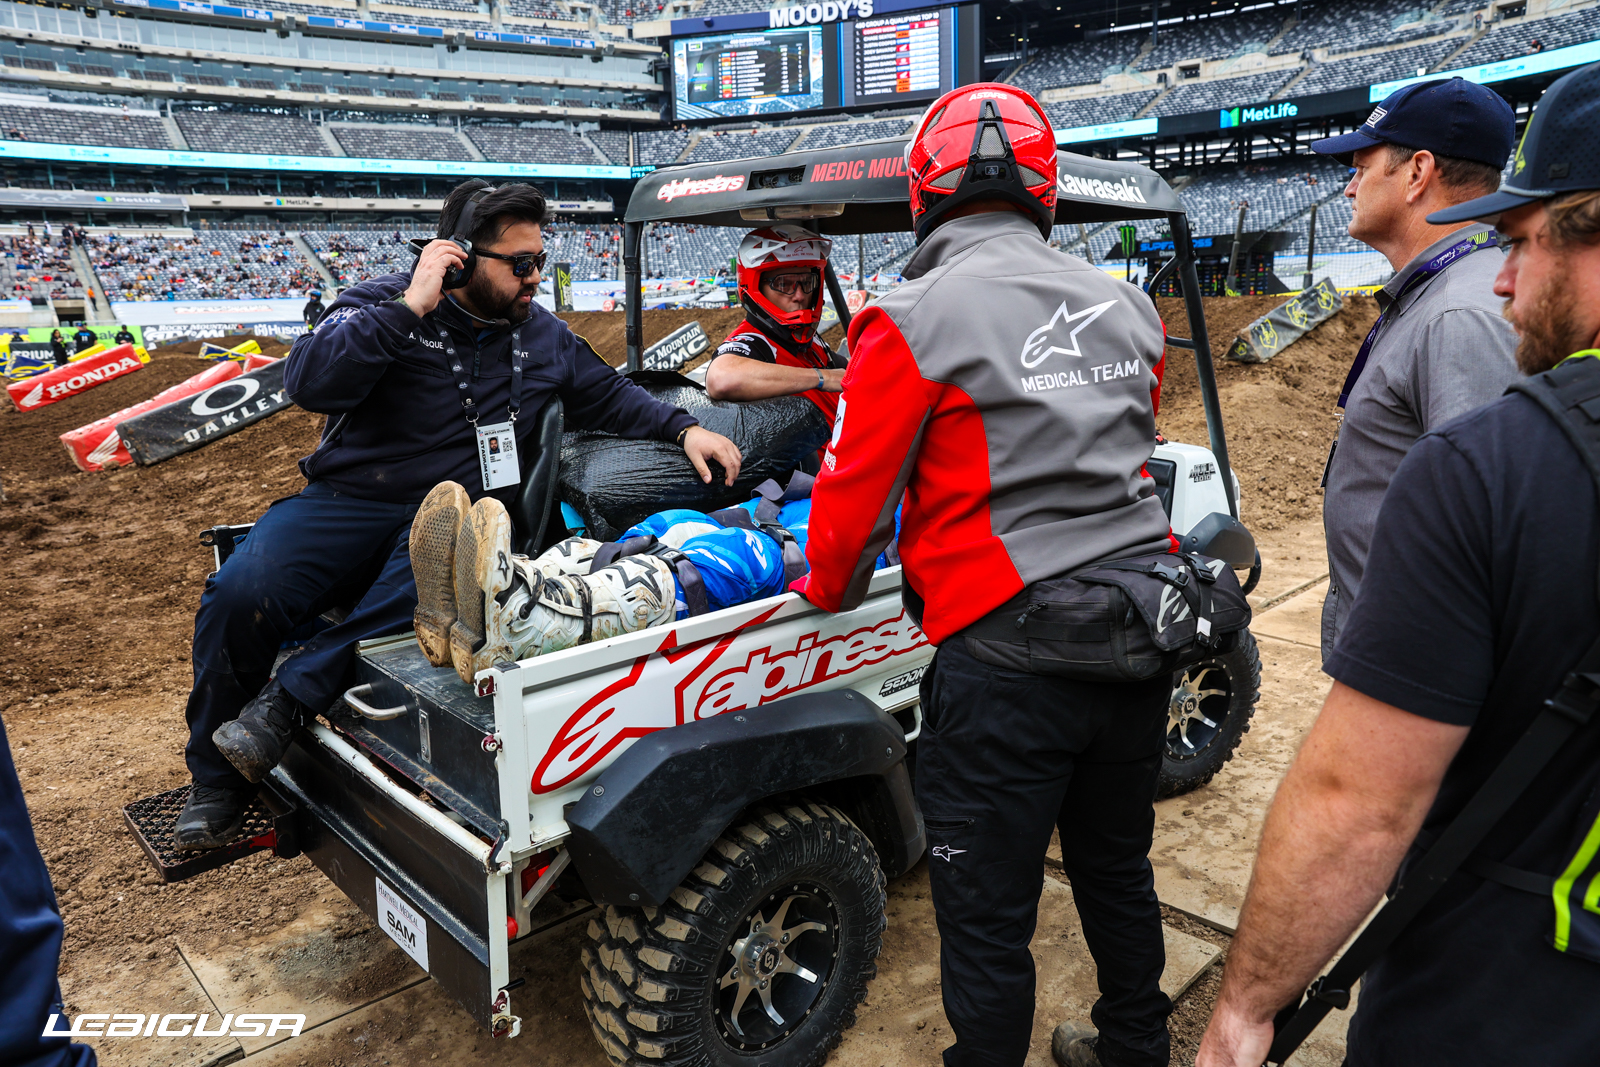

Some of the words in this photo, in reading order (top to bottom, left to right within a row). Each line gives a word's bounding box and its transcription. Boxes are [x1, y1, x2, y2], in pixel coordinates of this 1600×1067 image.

[769, 0, 874, 28] MOODY'S
[866, 19, 884, 28] GROUP
[890, 14, 921, 25] QUALIFYING
[969, 92, 1008, 101] ASTARS
[1242, 102, 1298, 123] MetLife
[810, 160, 864, 182] MEDIC
[867, 156, 910, 178] MUL
[115, 196, 161, 204] MetLife
[658, 174, 744, 203] alpinestars
[1338, 288, 1373, 297] UZUKI
[158, 324, 188, 332] ROCKY
[409, 332, 416, 340] A.
[12, 346, 77, 360] TRIUMH
[656, 324, 700, 362] MOUNTAIN
[46, 356, 140, 398] HONDA
[1020, 370, 1088, 392] MEDICAL
[1090, 359, 1140, 383] TEAM
[183, 390, 286, 444] OAKLEY
[694, 607, 932, 720] alpinesta
[881, 664, 930, 693] SEDON
[400, 902, 418, 928] MEDICAL
[387, 910, 416, 948] SAM
